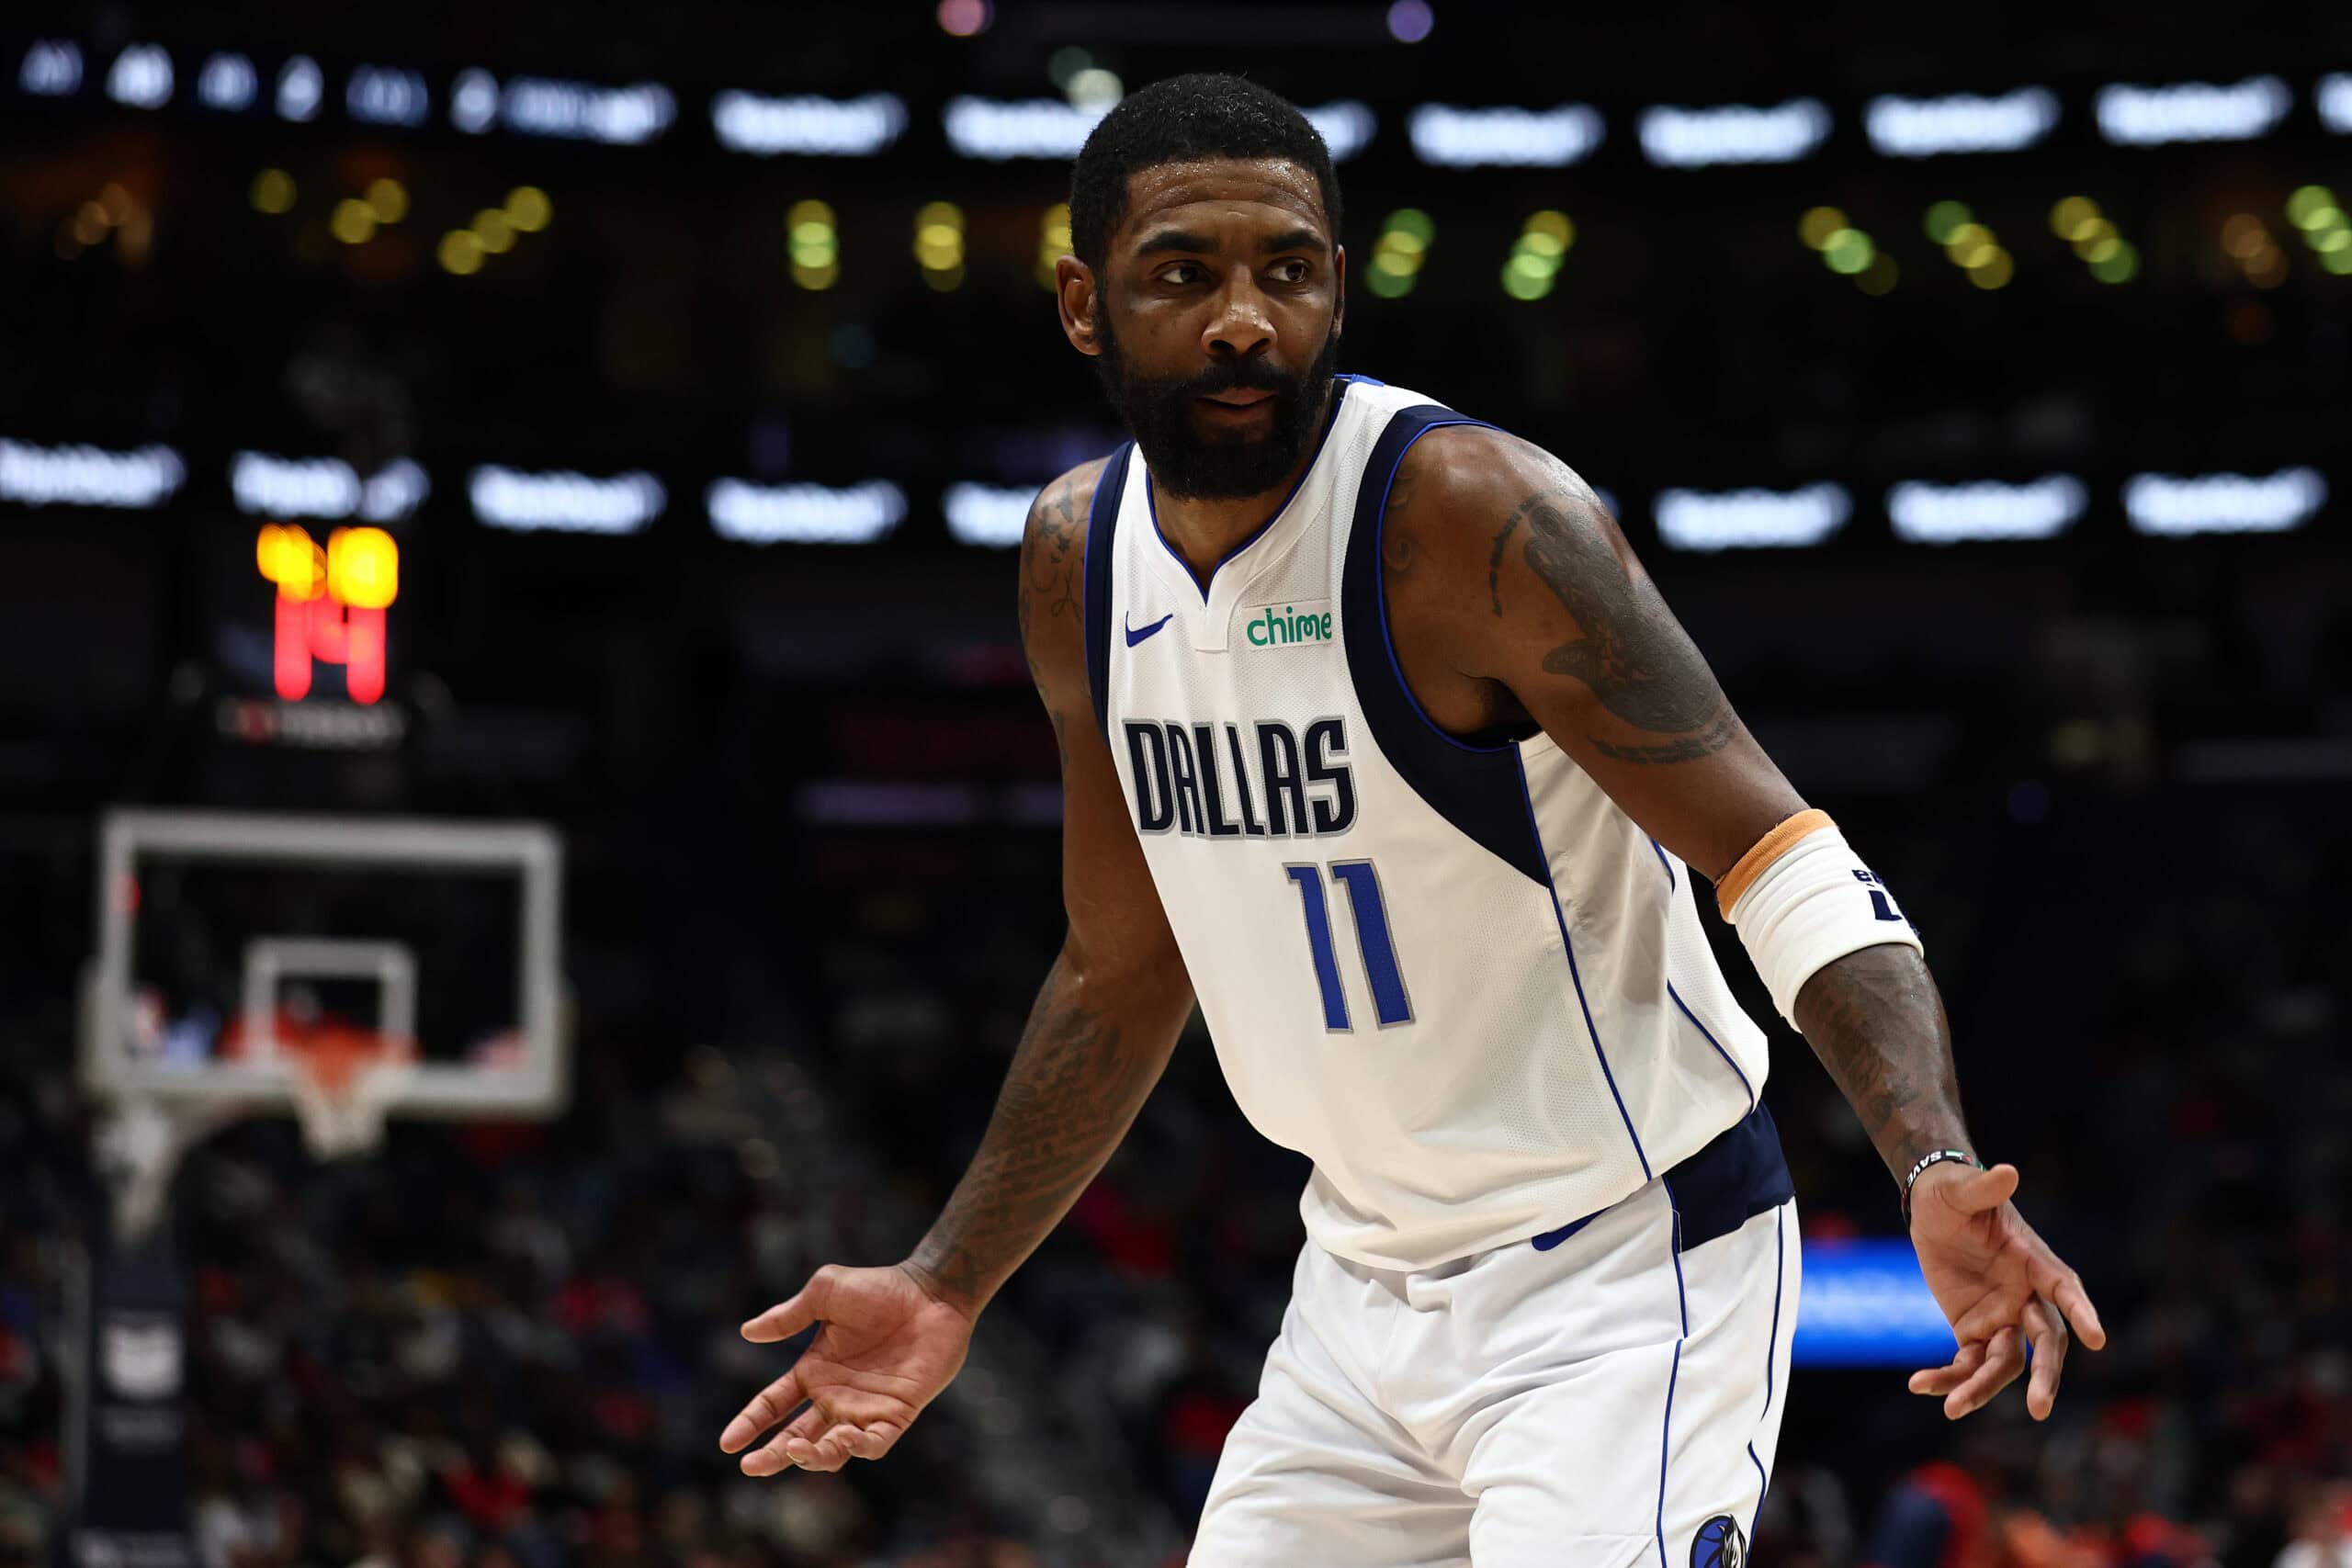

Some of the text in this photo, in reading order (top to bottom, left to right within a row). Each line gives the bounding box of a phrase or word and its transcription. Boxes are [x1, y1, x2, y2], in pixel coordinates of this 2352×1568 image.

[1247, 605, 1332, 647] chime
[1121, 715, 1360, 840] DALLAS
[1282, 858, 1416, 1034] 11
[1906, 1150, 1942, 1188] SAVE
